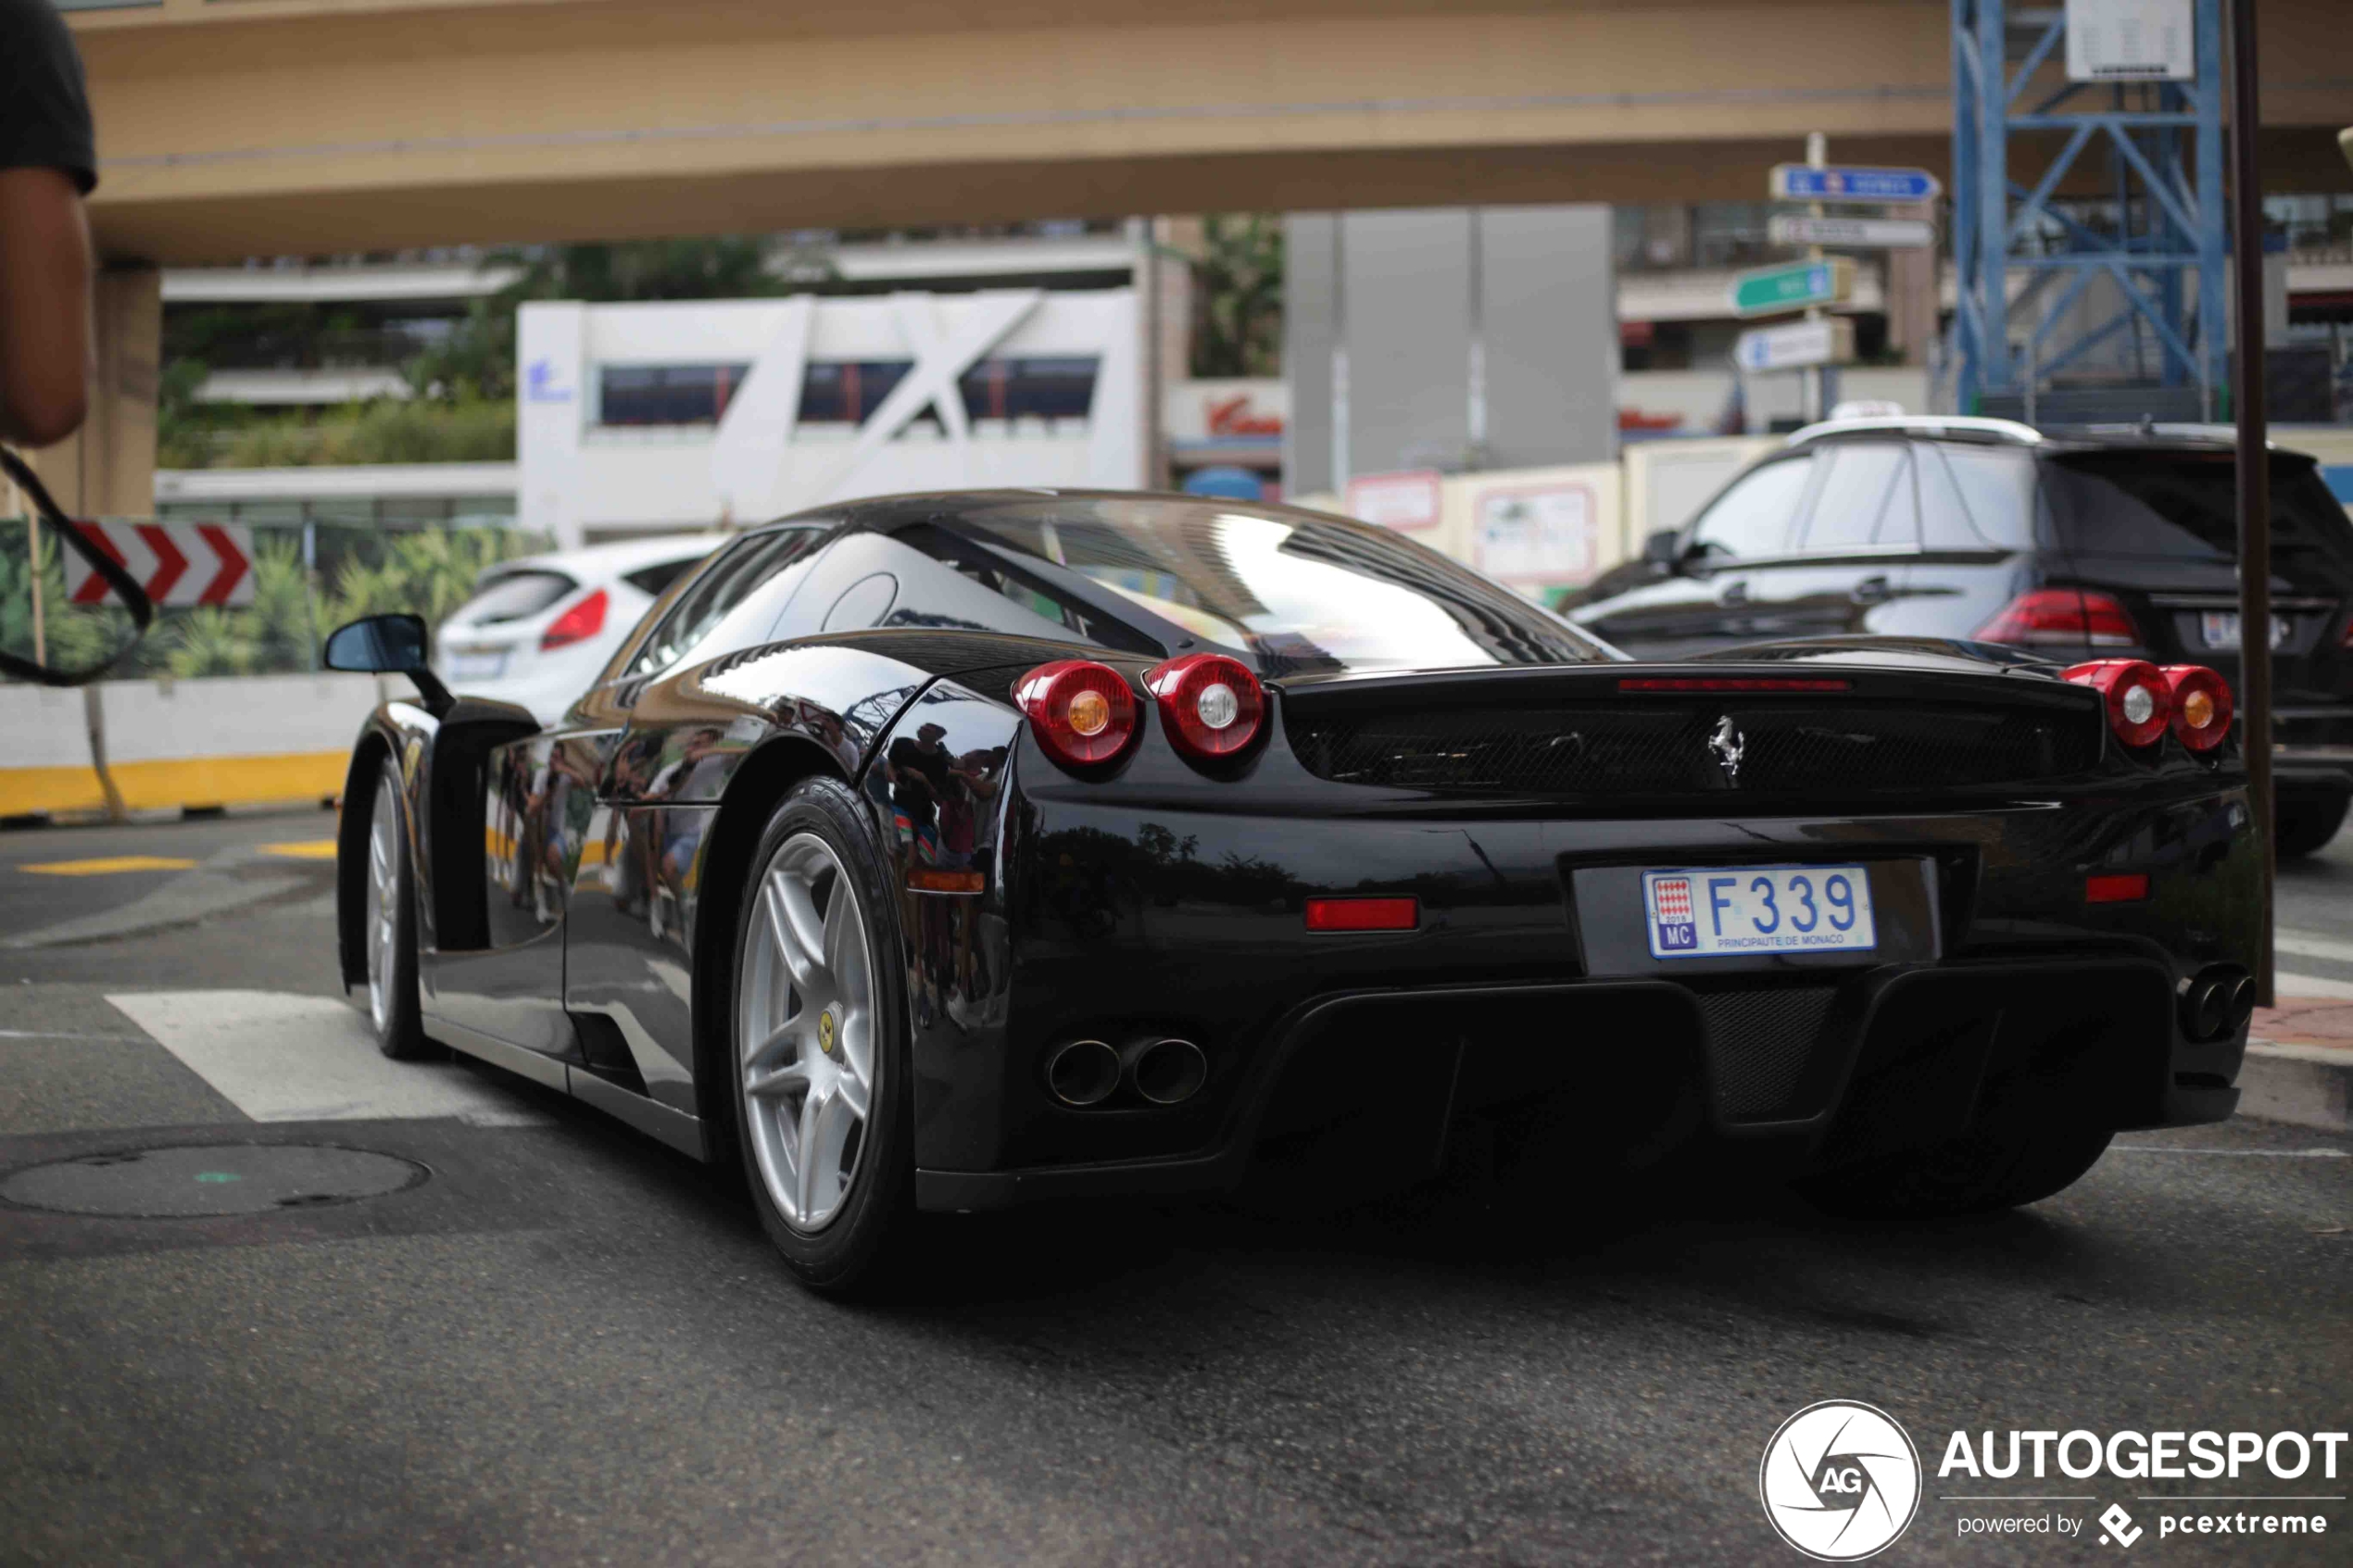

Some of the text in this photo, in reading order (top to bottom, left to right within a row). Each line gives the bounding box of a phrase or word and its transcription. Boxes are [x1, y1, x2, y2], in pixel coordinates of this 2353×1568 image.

[1708, 874, 1856, 935] F339
[1667, 926, 1691, 945] MC
[1718, 935, 1844, 947] PRINCIPAUTE DE MONACO
